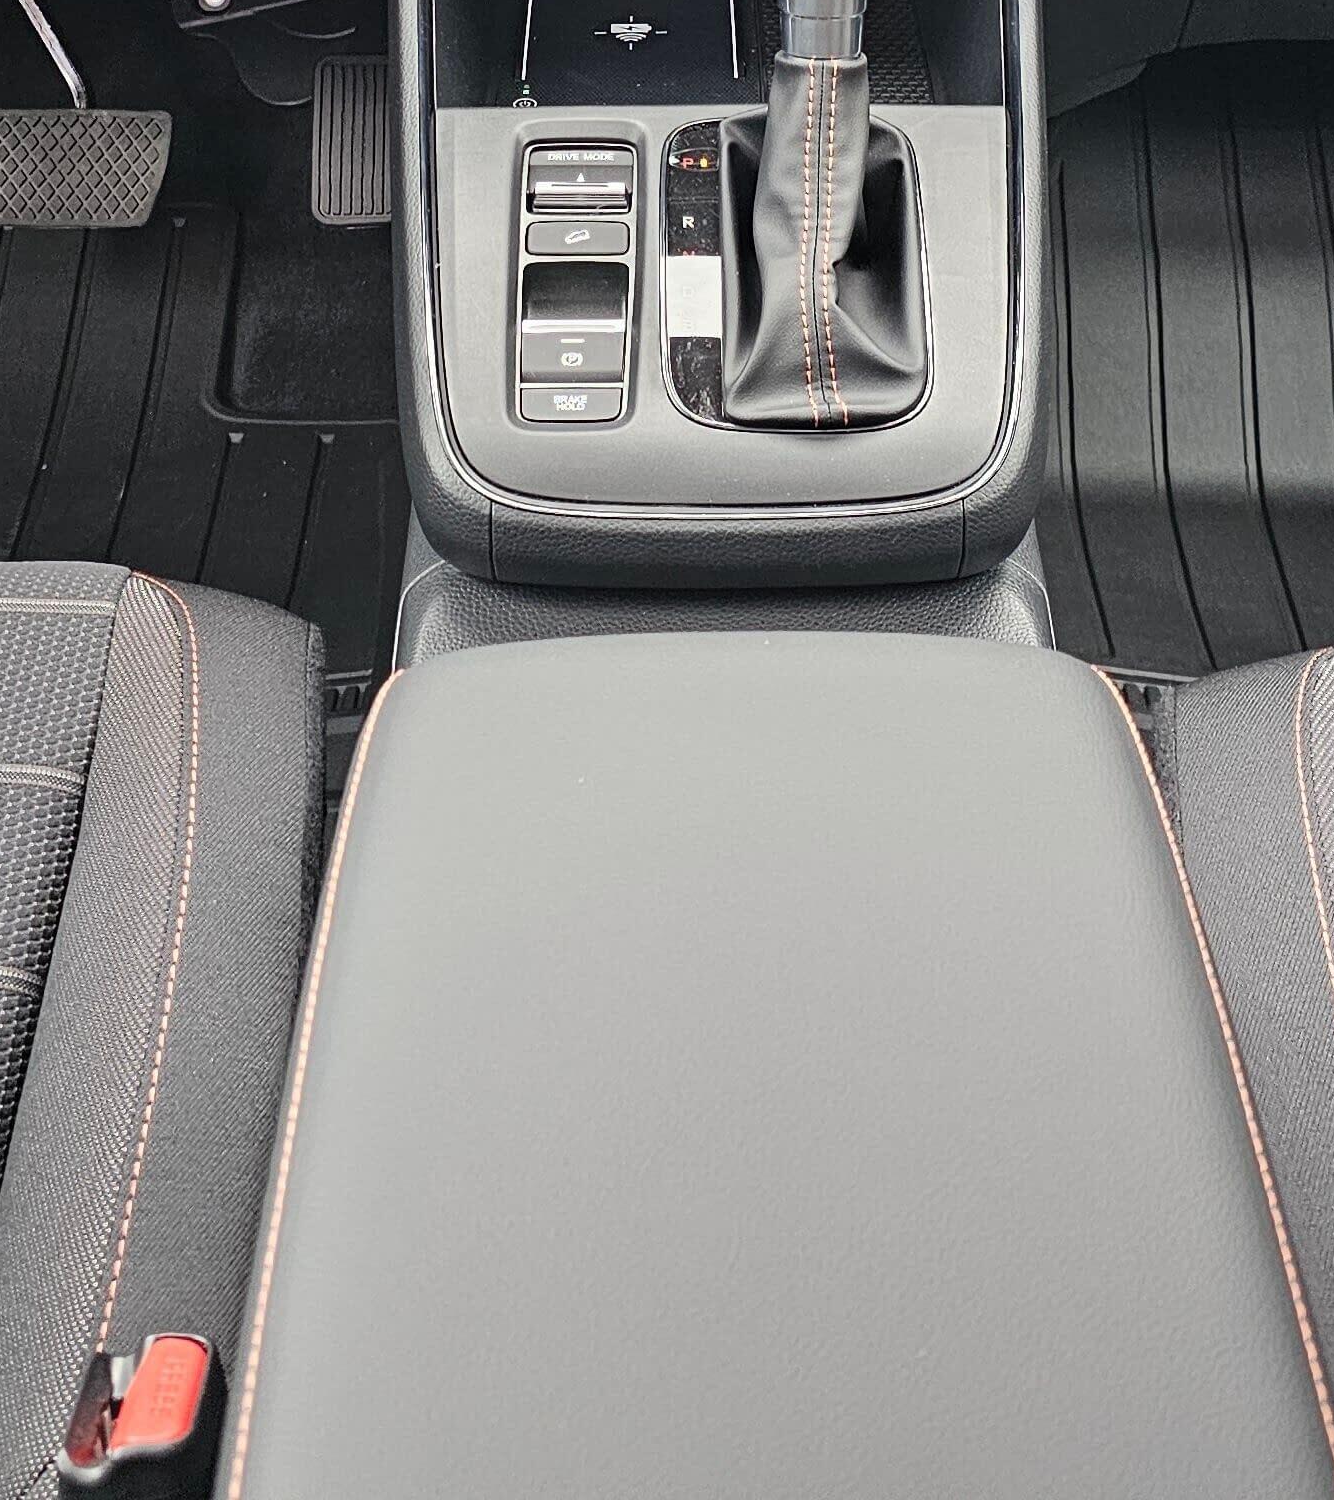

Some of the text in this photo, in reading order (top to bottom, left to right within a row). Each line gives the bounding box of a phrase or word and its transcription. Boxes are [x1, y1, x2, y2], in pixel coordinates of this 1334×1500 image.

[547, 153, 615, 161] DRIVE MODE
[682, 157, 694, 168] P
[682, 216, 695, 229] R
[553, 394, 588, 405] BRAKE
[556, 403, 586, 412] HOLD
